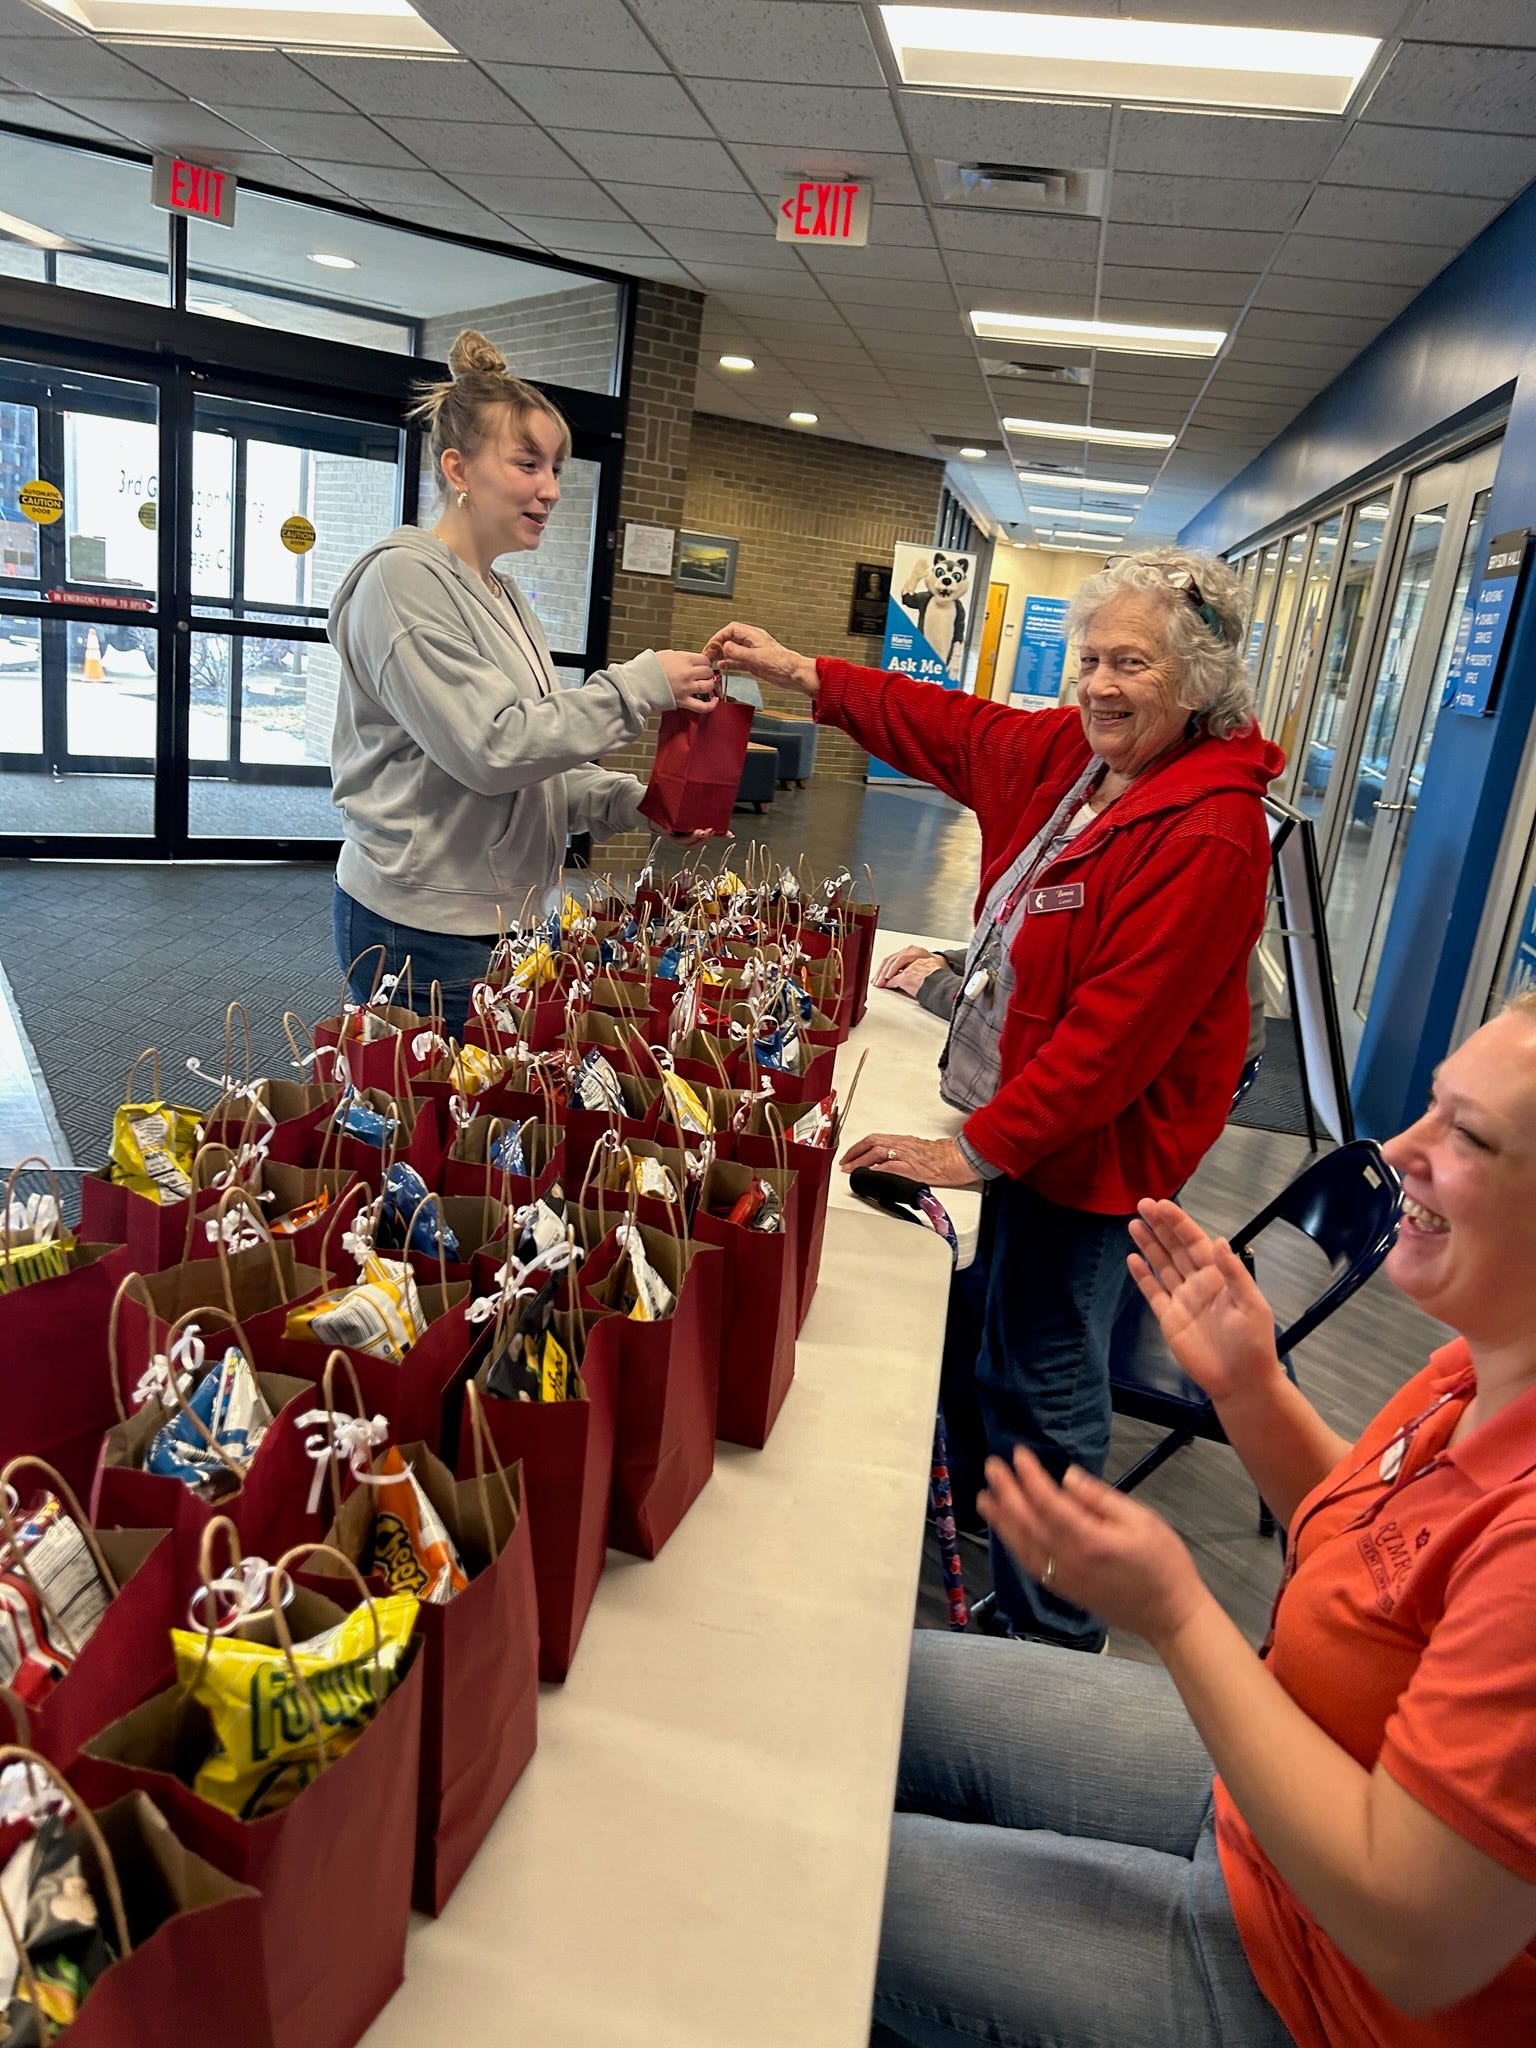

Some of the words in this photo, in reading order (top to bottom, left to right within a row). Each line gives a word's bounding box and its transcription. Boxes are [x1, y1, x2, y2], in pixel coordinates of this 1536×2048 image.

[171, 160, 226, 218] EXIT
[794, 182, 859, 238] EXIT
[118, 469, 142, 496] 3rd
[23, 488, 60, 499] AUTOMATIC
[21, 496, 62, 509] CAUTION
[32, 506, 51, 515] DOOR
[282, 529, 315, 541] CAUTION
[1507, 550, 1521, 566] HALL
[63, 593, 100, 605] EMERGENCY
[887, 656, 918, 673] Ask
[919, 658, 944, 675] Me
[374, 1514, 426, 1593] Cheet
